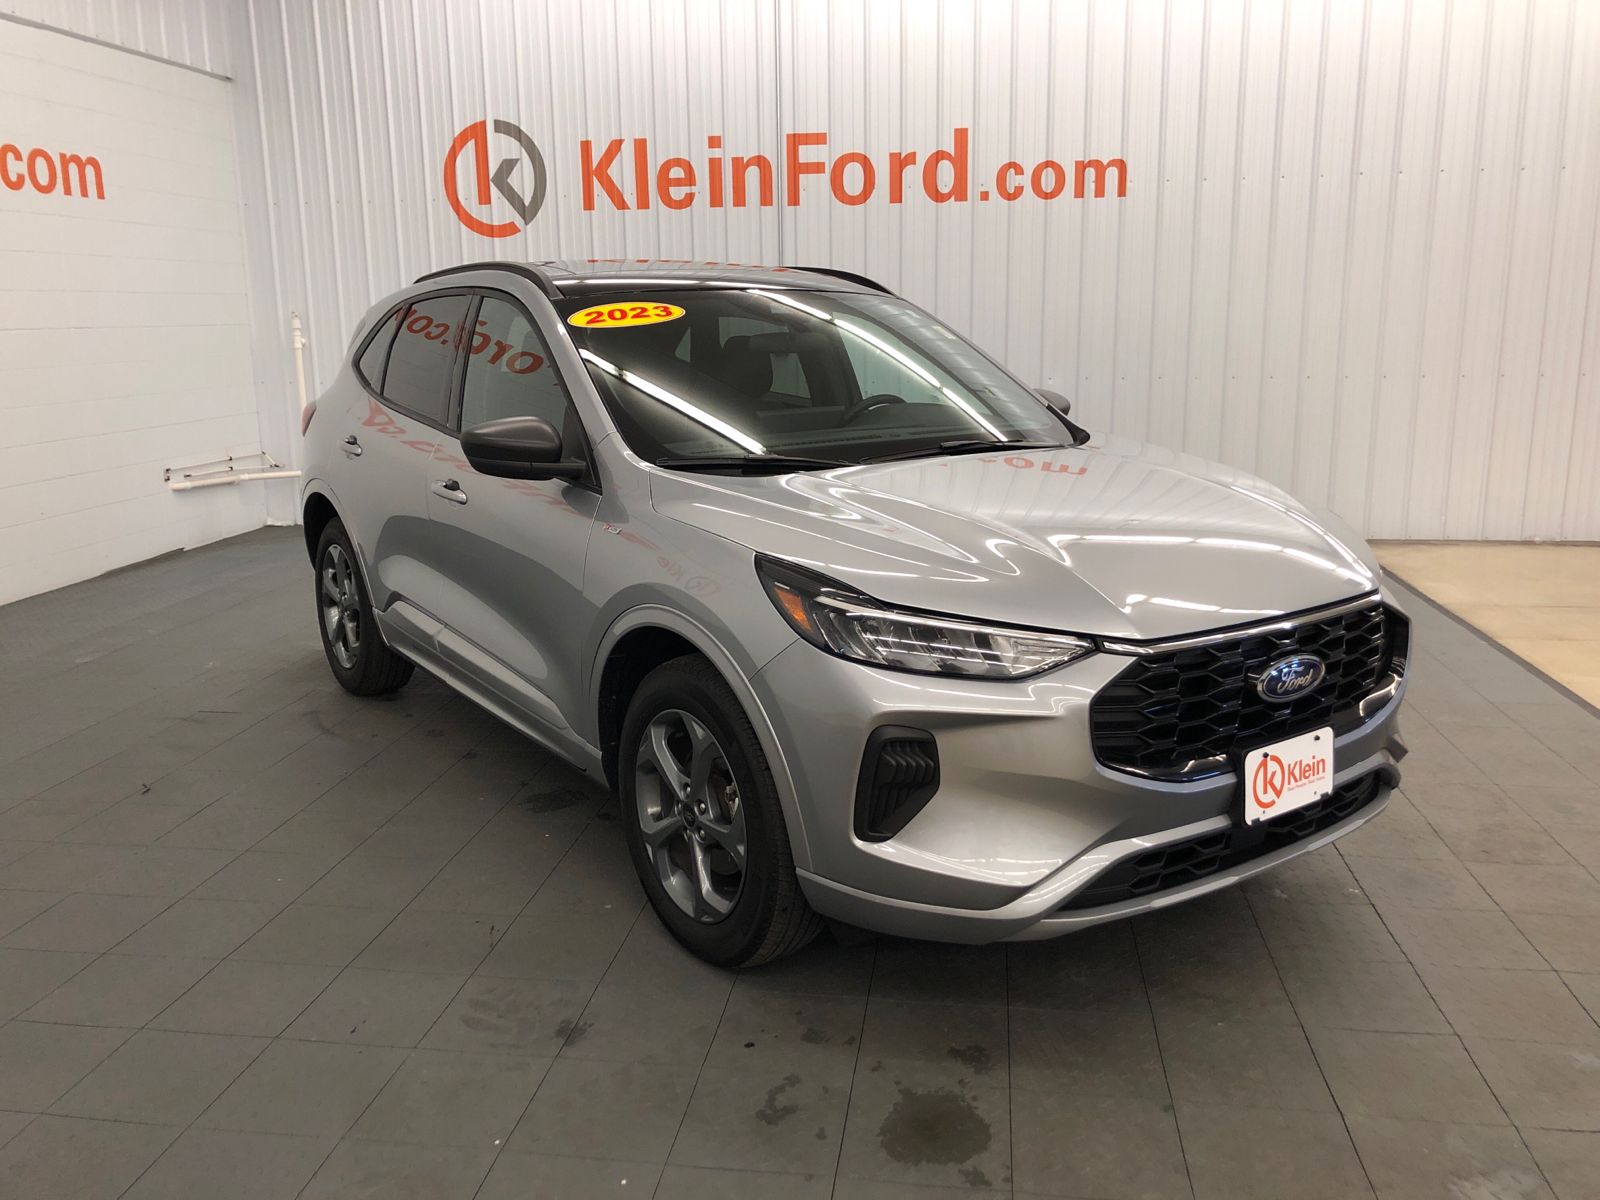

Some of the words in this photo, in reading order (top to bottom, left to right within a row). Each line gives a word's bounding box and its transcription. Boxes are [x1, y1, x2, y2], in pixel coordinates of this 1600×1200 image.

[579, 127, 1128, 212] KleinFord.com
[584, 305, 674, 325] 2023
[1277, 665, 1314, 694] Ford
[1287, 755, 1326, 786] Klein
